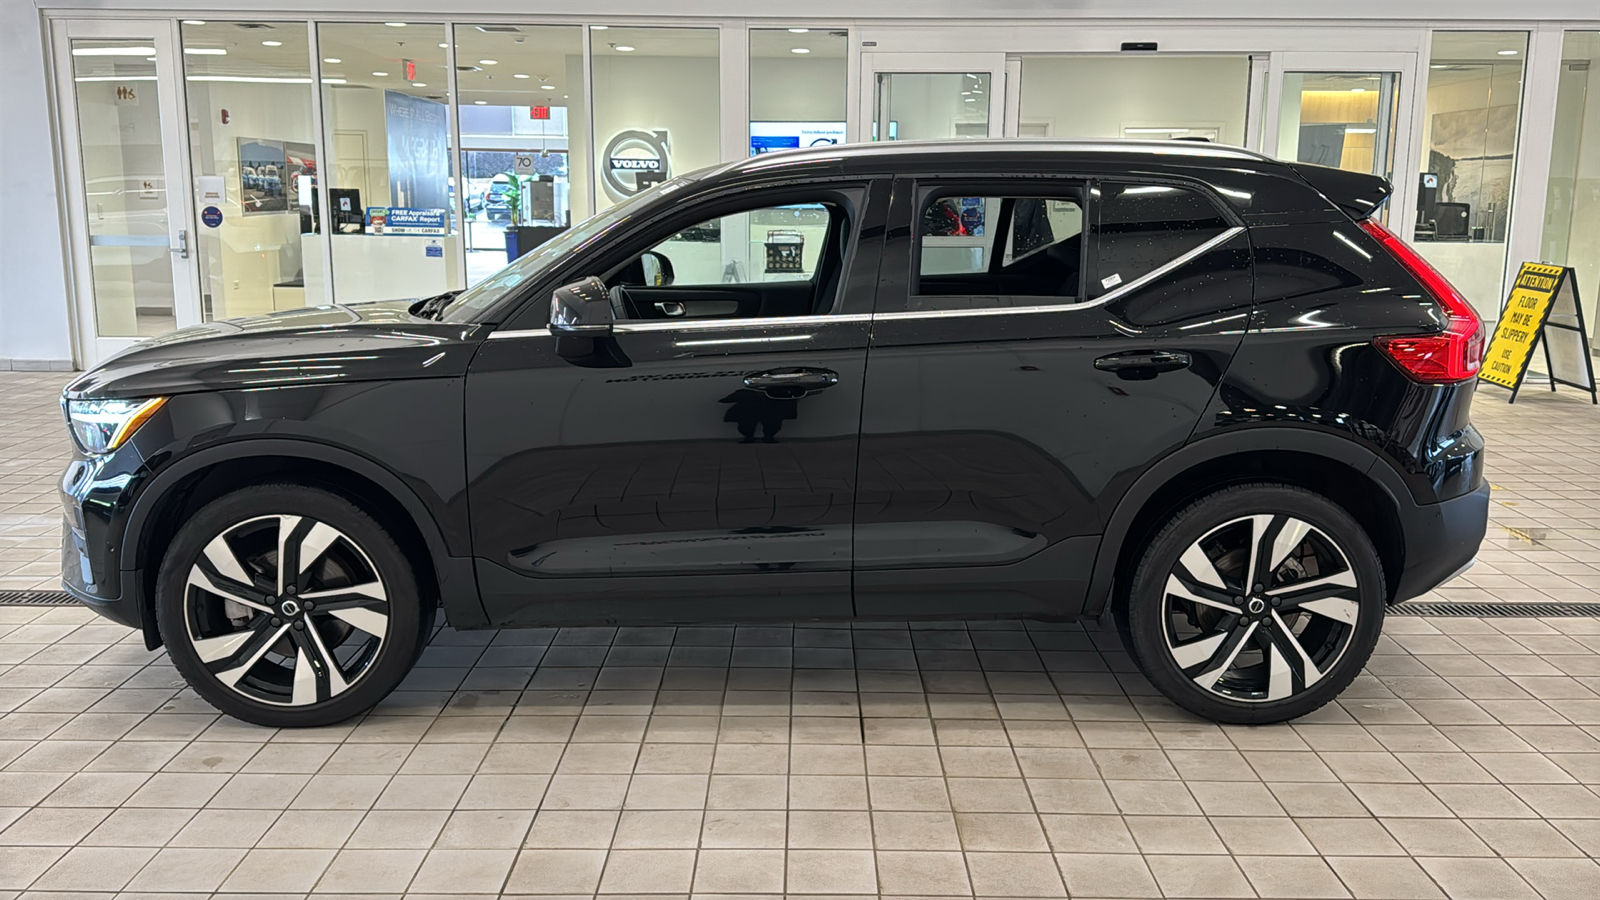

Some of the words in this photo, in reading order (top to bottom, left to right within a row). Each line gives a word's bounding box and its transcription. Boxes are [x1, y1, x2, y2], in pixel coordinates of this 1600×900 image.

[533, 106, 548, 118] EXIT
[516, 157, 531, 167] 70
[611, 159, 659, 168] VOLVO
[1521, 276, 1554, 290] ATTENTION
[1518, 296, 1538, 309] FLOOR
[1510, 312, 1524, 324] MAY
[1522, 314, 1533, 326] BE
[1501, 328, 1529, 343] SLIPPERY
[1501, 349, 1512, 360] USE
[1491, 361, 1512, 374] CAUTION
